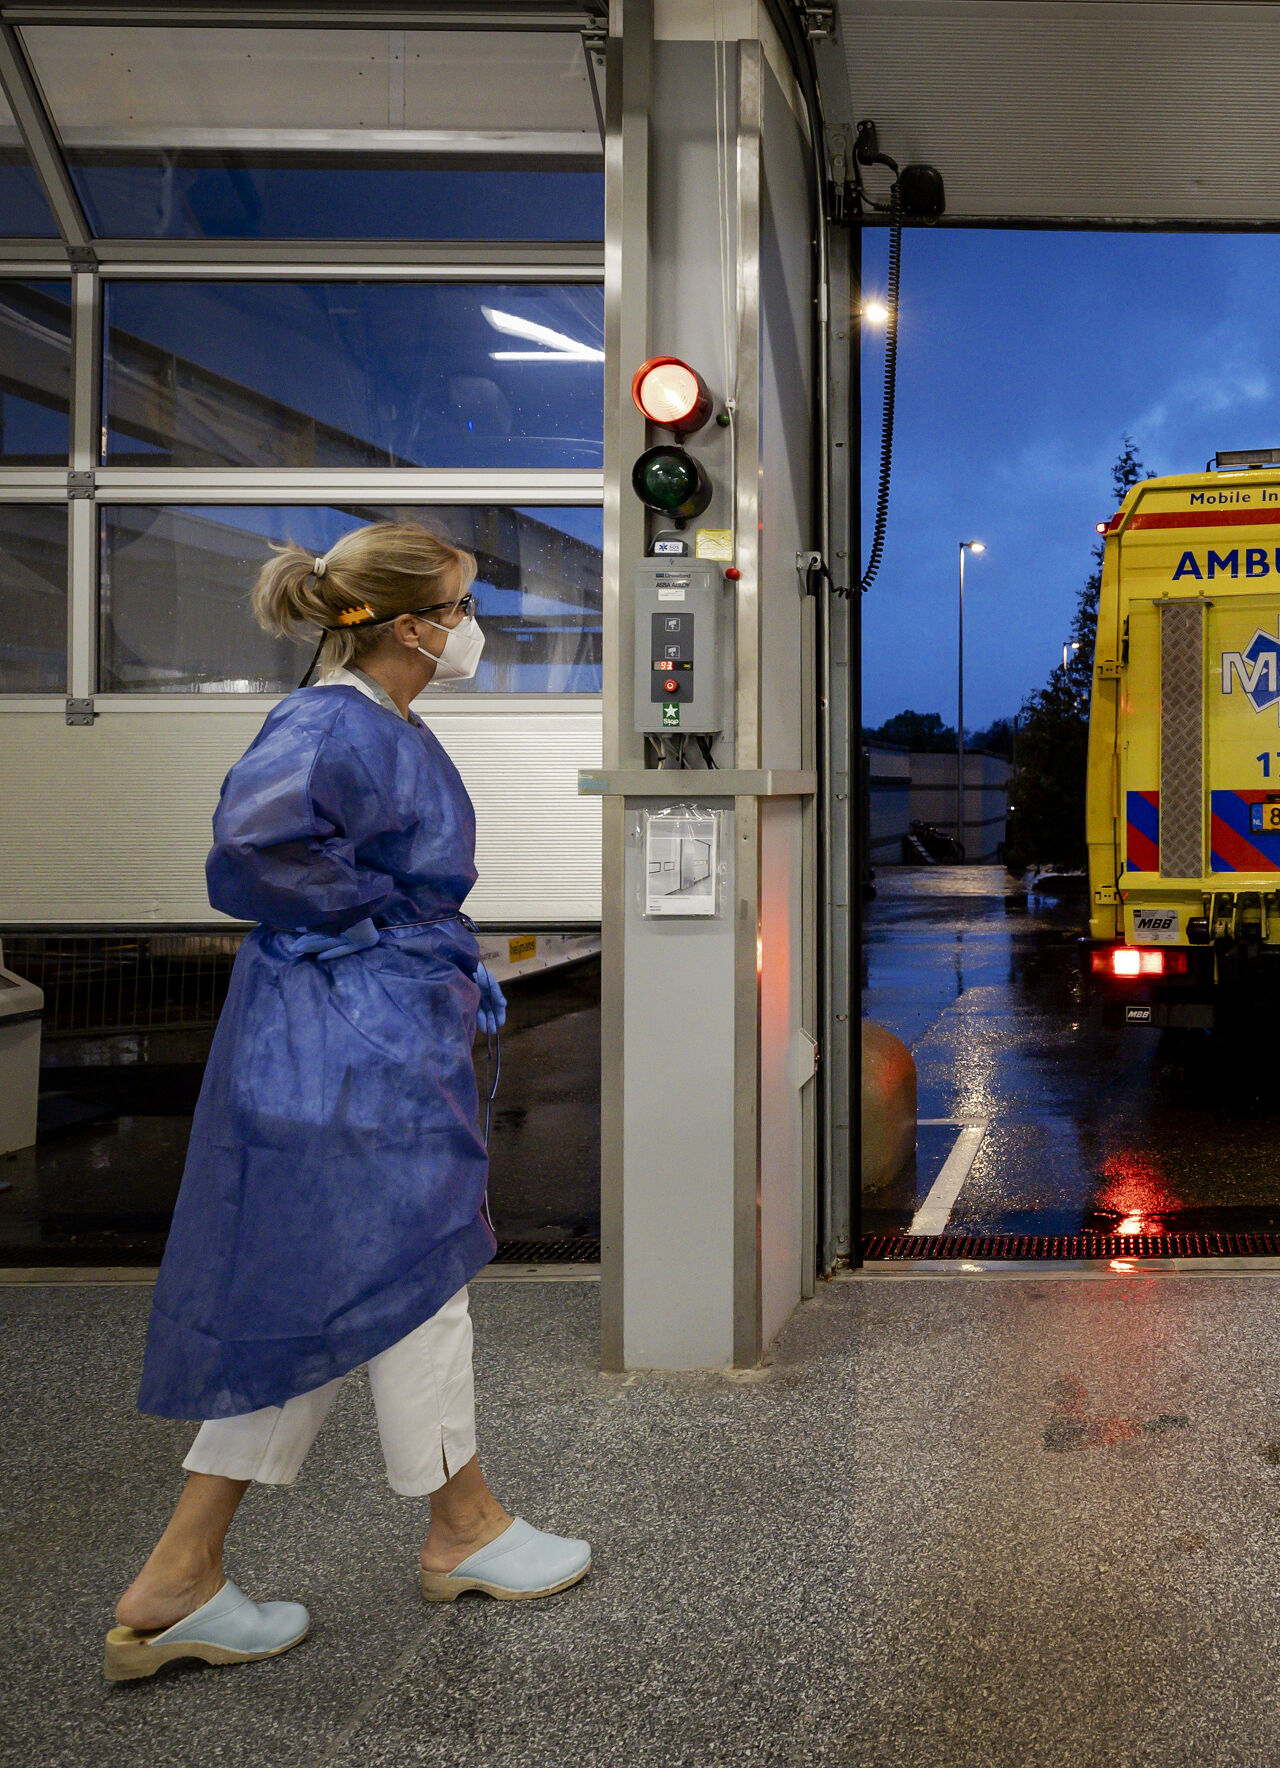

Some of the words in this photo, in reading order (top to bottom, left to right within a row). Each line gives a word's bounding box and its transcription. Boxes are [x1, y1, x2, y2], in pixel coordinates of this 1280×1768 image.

[1190, 490, 1251, 505] Mobile
[1137, 918, 1173, 929] MBB
[1127, 1010, 1149, 1018] MBB
